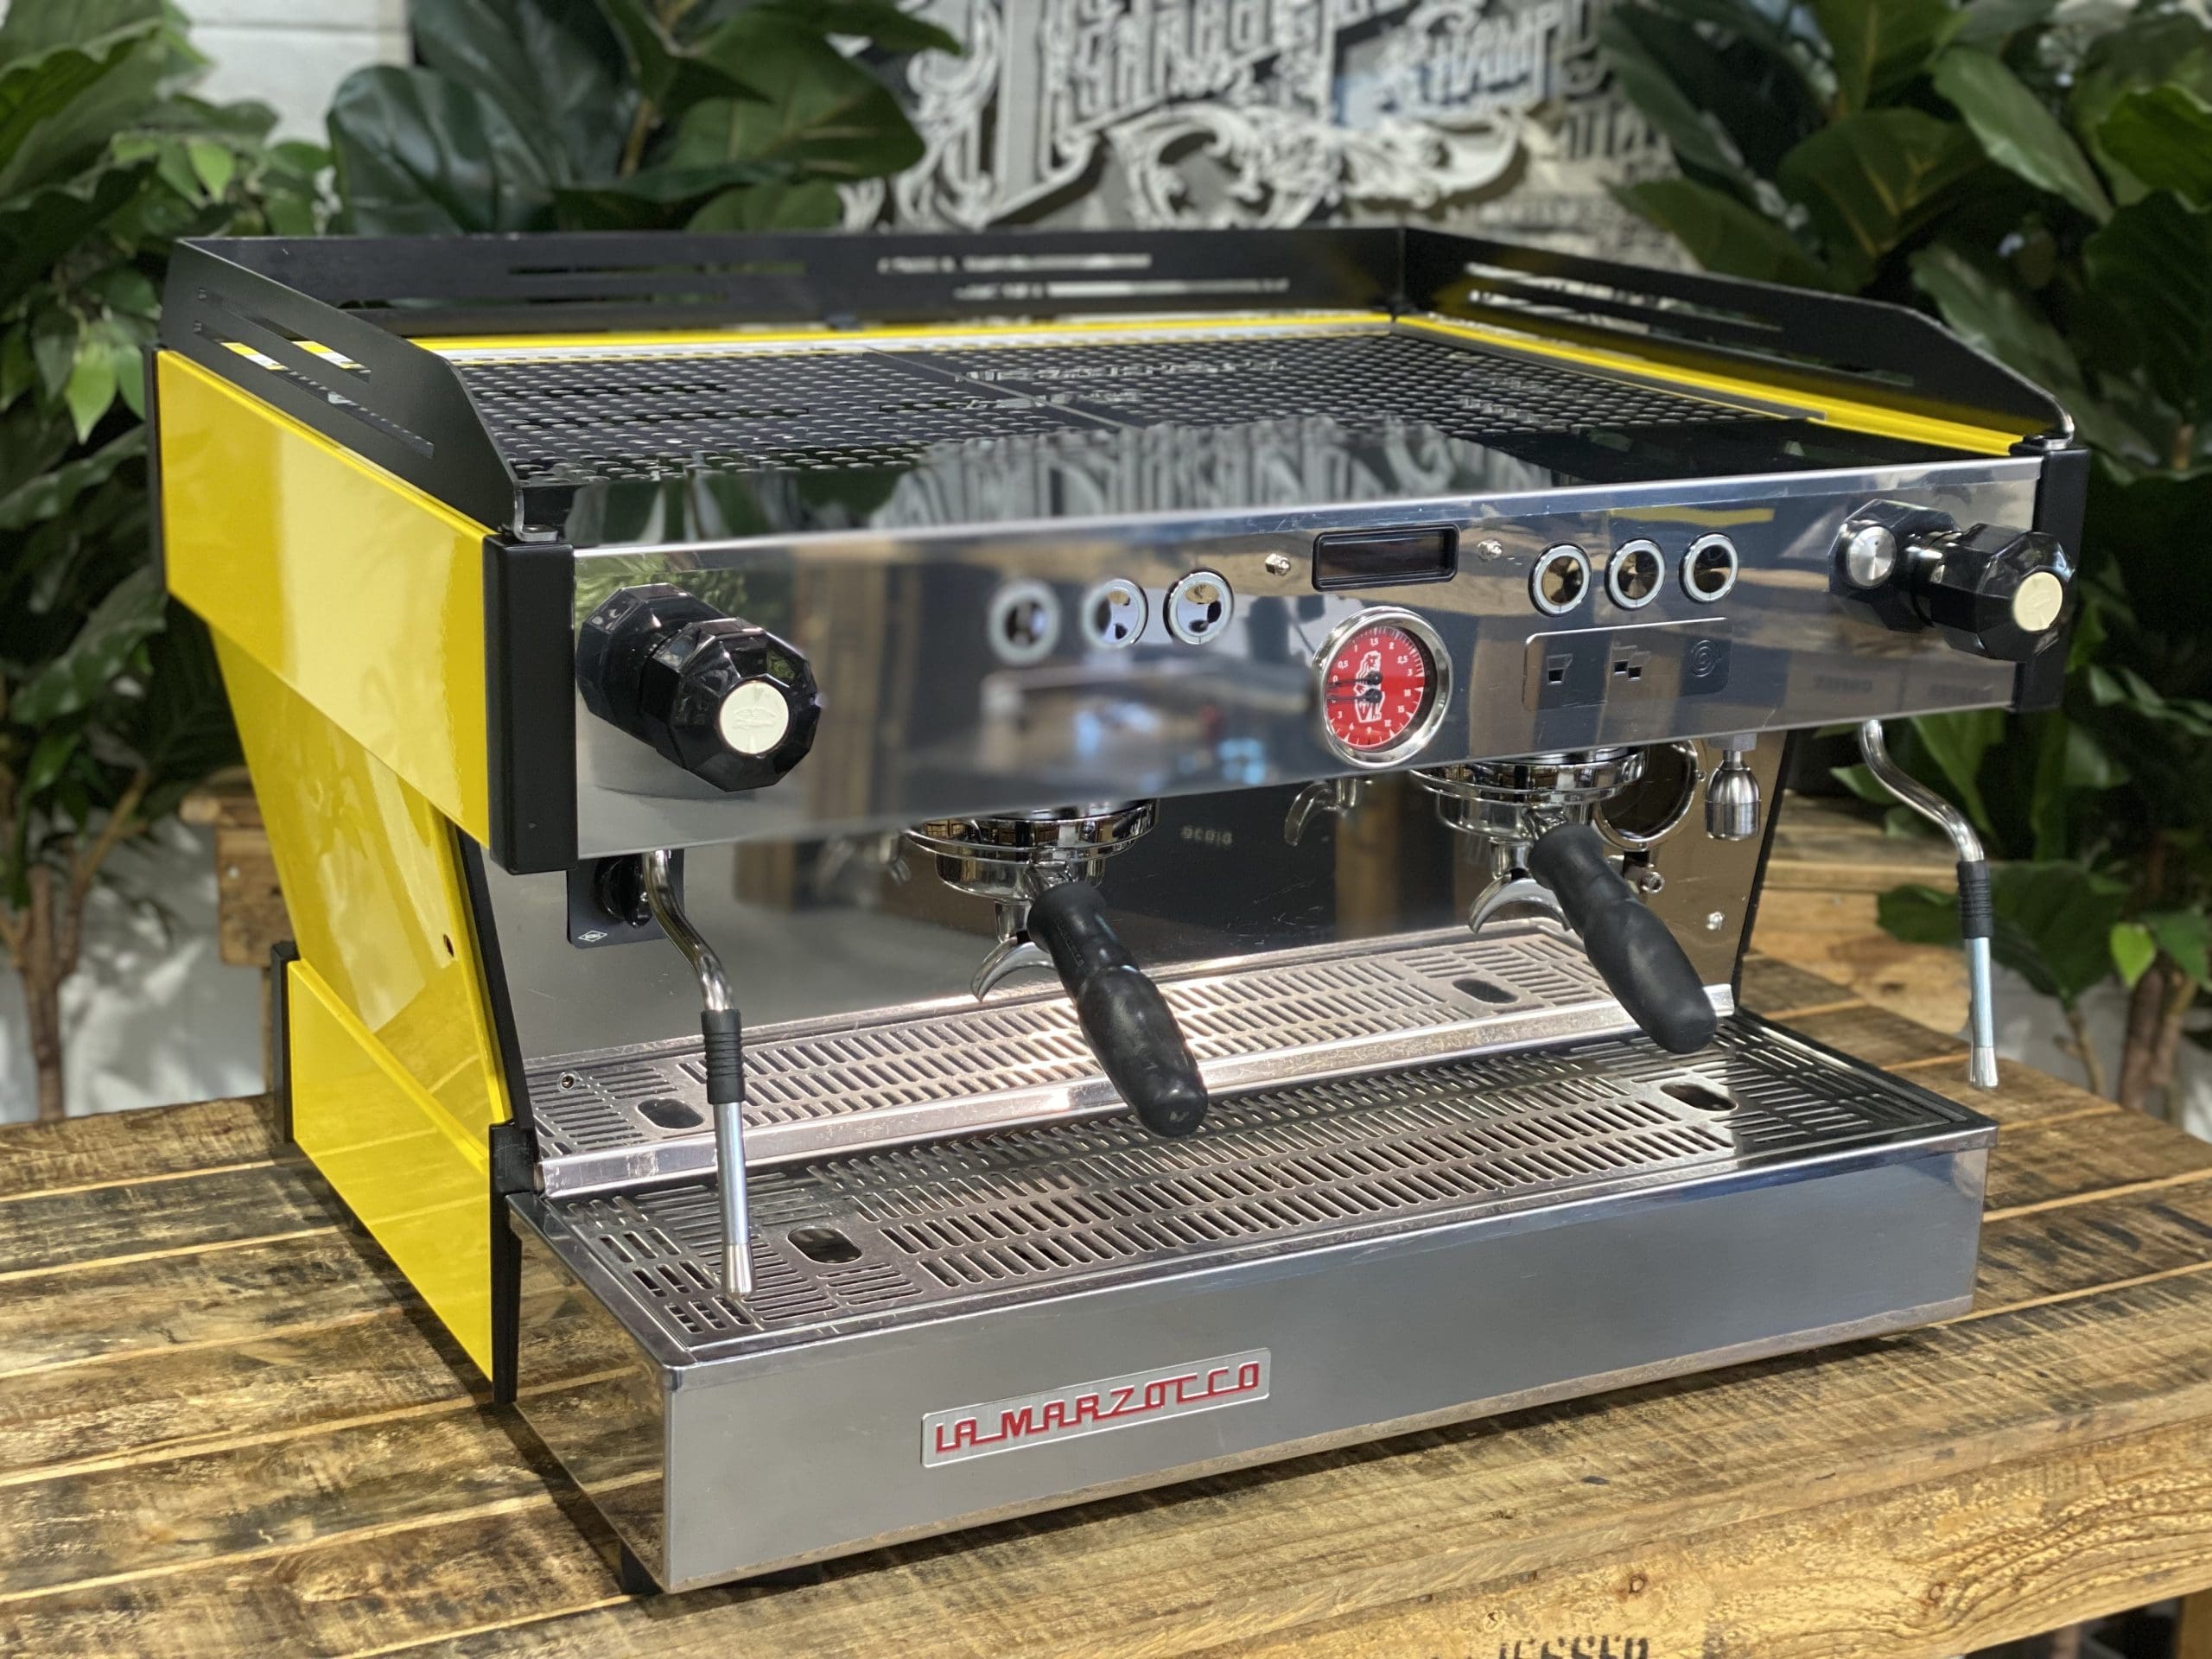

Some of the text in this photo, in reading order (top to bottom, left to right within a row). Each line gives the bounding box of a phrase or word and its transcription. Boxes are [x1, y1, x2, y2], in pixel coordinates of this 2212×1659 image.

[1338, 660, 1349, 670] 0,5
[1397, 705, 1405, 714] 15
[1384, 719, 1392, 728] 12
[936, 1361, 1260, 1453] LA MARZOCCO
